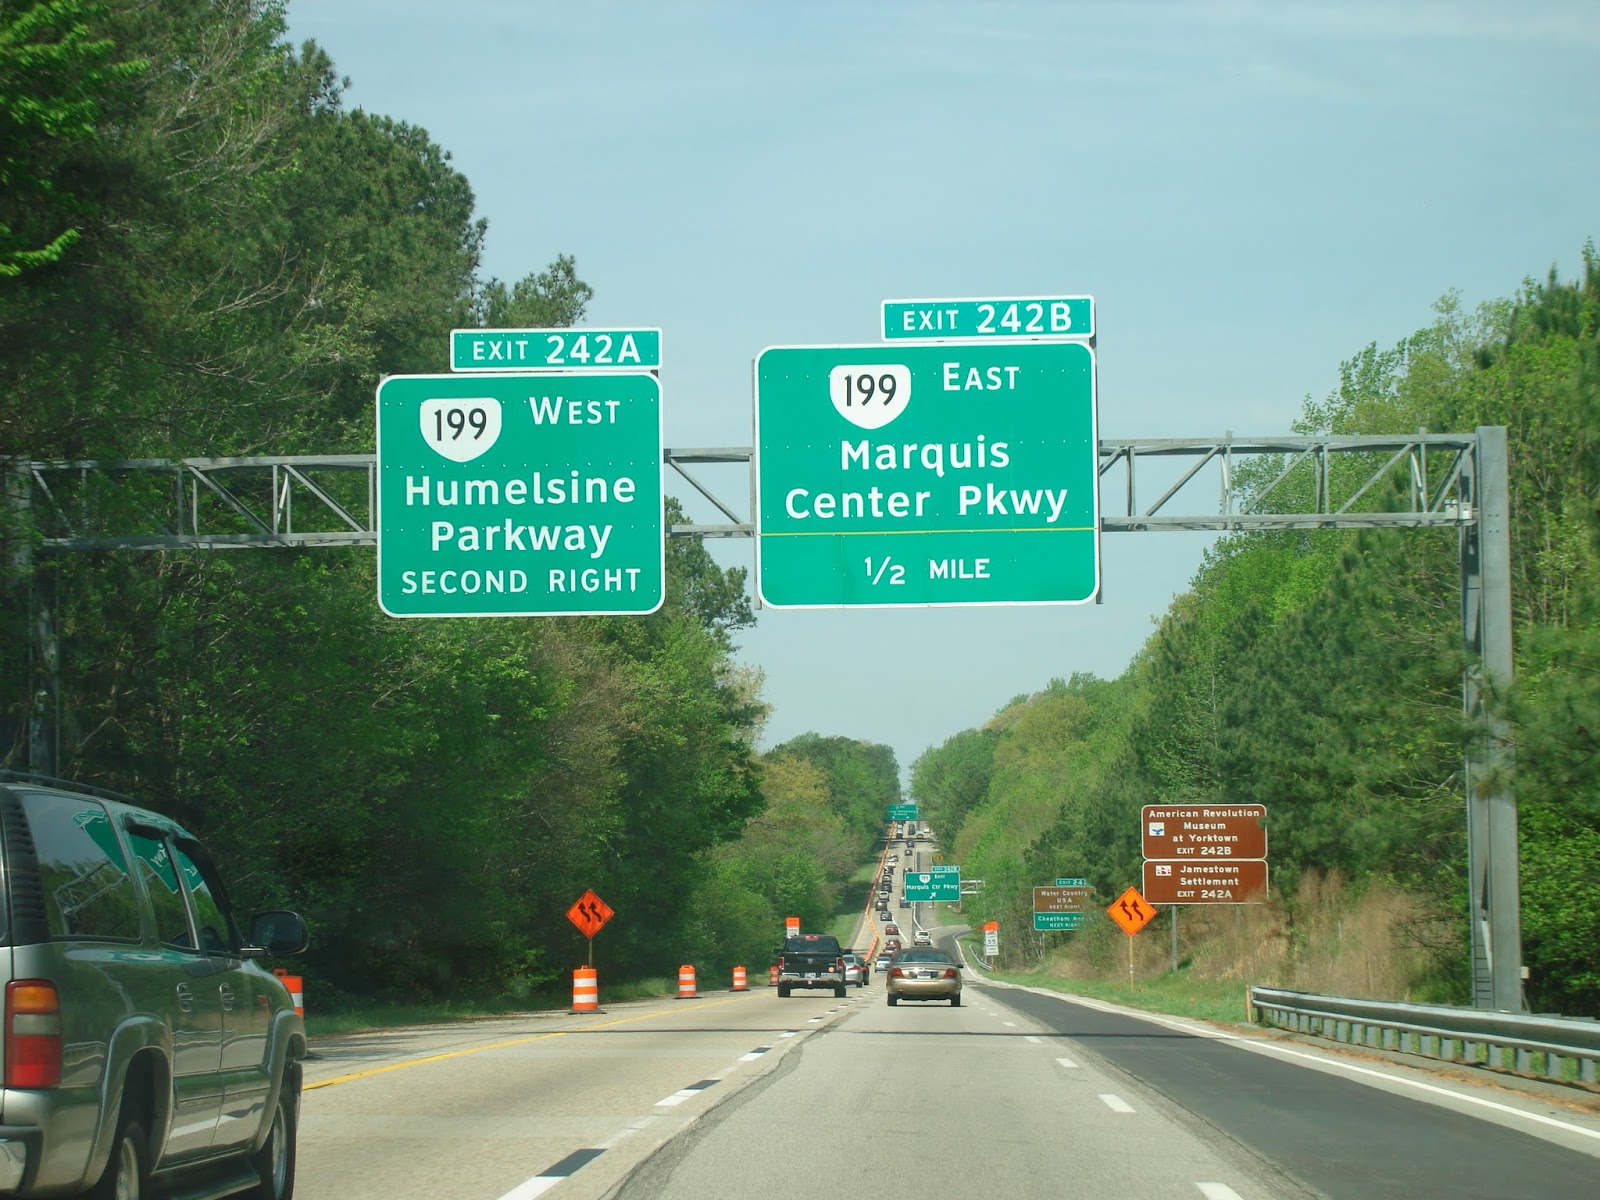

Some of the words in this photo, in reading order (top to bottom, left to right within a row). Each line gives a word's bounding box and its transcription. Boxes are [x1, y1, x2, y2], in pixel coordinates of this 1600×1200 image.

[903, 309, 960, 331] EXIT
[977, 303, 1072, 333] 242B
[473, 340, 529, 361] EXIT
[546, 334, 641, 364] 242A
[844, 374, 898, 407] 199
[943, 362, 1021, 391] EAST
[434, 408, 487, 441] 199
[528, 396, 620, 425] WEST
[841, 434, 1010, 478] Marquis
[405, 470, 636, 506] Humelsine
[785, 486, 931, 519] Center
[959, 483, 1068, 523] Pkwy
[431, 519, 613, 559] Parkway
[401, 570, 528, 594] SECOND
[549, 568, 641, 592] RIGHT
[929, 558, 990, 579] MILE
[1148, 809, 1199, 818] American
[1203, 808, 1260, 818] Revolution
[1183, 822, 1227, 830] Museum
[1172, 835, 1184, 843] at
[1188, 834, 1239, 842] Yorktown
[1200, 846, 1232, 855] 242B
[1179, 865, 1239, 873] Jamestown
[1180, 877, 1240, 886] Settlement
[1201, 889, 1233, 898] 242A
